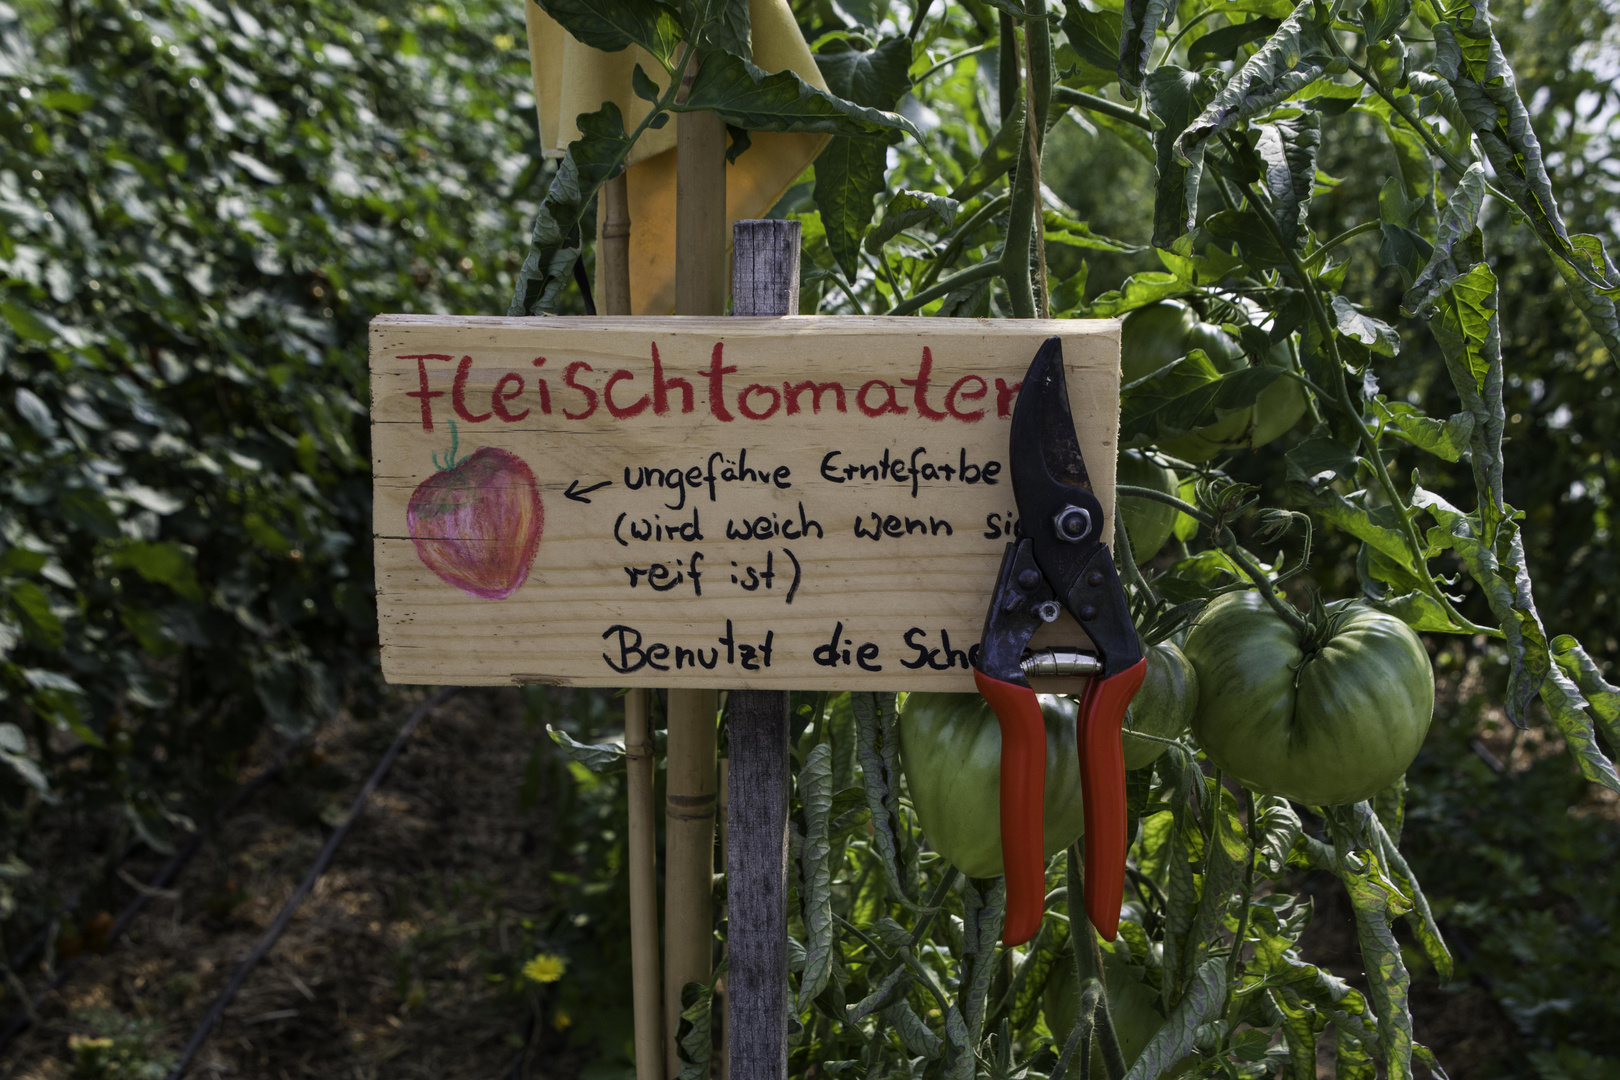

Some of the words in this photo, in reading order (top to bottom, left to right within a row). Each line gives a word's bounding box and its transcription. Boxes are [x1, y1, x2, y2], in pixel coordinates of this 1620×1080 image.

[623, 448, 792, 510] ungefähre
[820, 446, 1002, 498] Erntefarbe
[613, 506, 704, 547] (wird
[725, 501, 824, 541] weich
[853, 511, 954, 541] wenn
[983, 510, 1021, 540] si
[623, 551, 705, 597] reif
[730, 547, 802, 604] ist)
[602, 618, 774, 674] Benutzt
[812, 620, 883, 672] die
